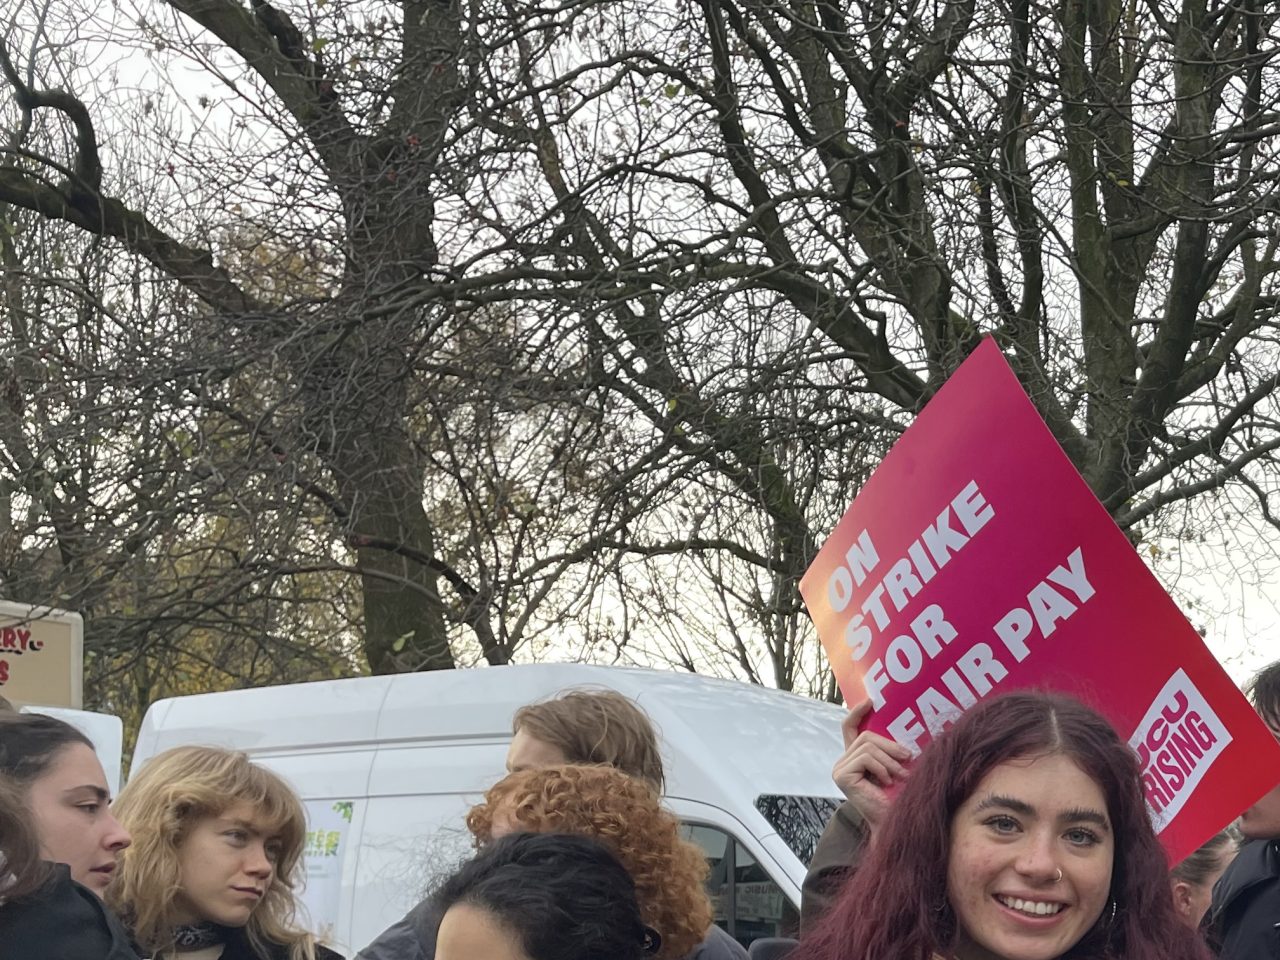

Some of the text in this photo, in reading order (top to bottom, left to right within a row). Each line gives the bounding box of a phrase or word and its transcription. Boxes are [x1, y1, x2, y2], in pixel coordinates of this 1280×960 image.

[828, 528, 880, 613] ON
[845, 480, 995, 661] STRIKE
[863, 604, 959, 713] FOR
[886, 546, 1097, 759] FAIR PAY
